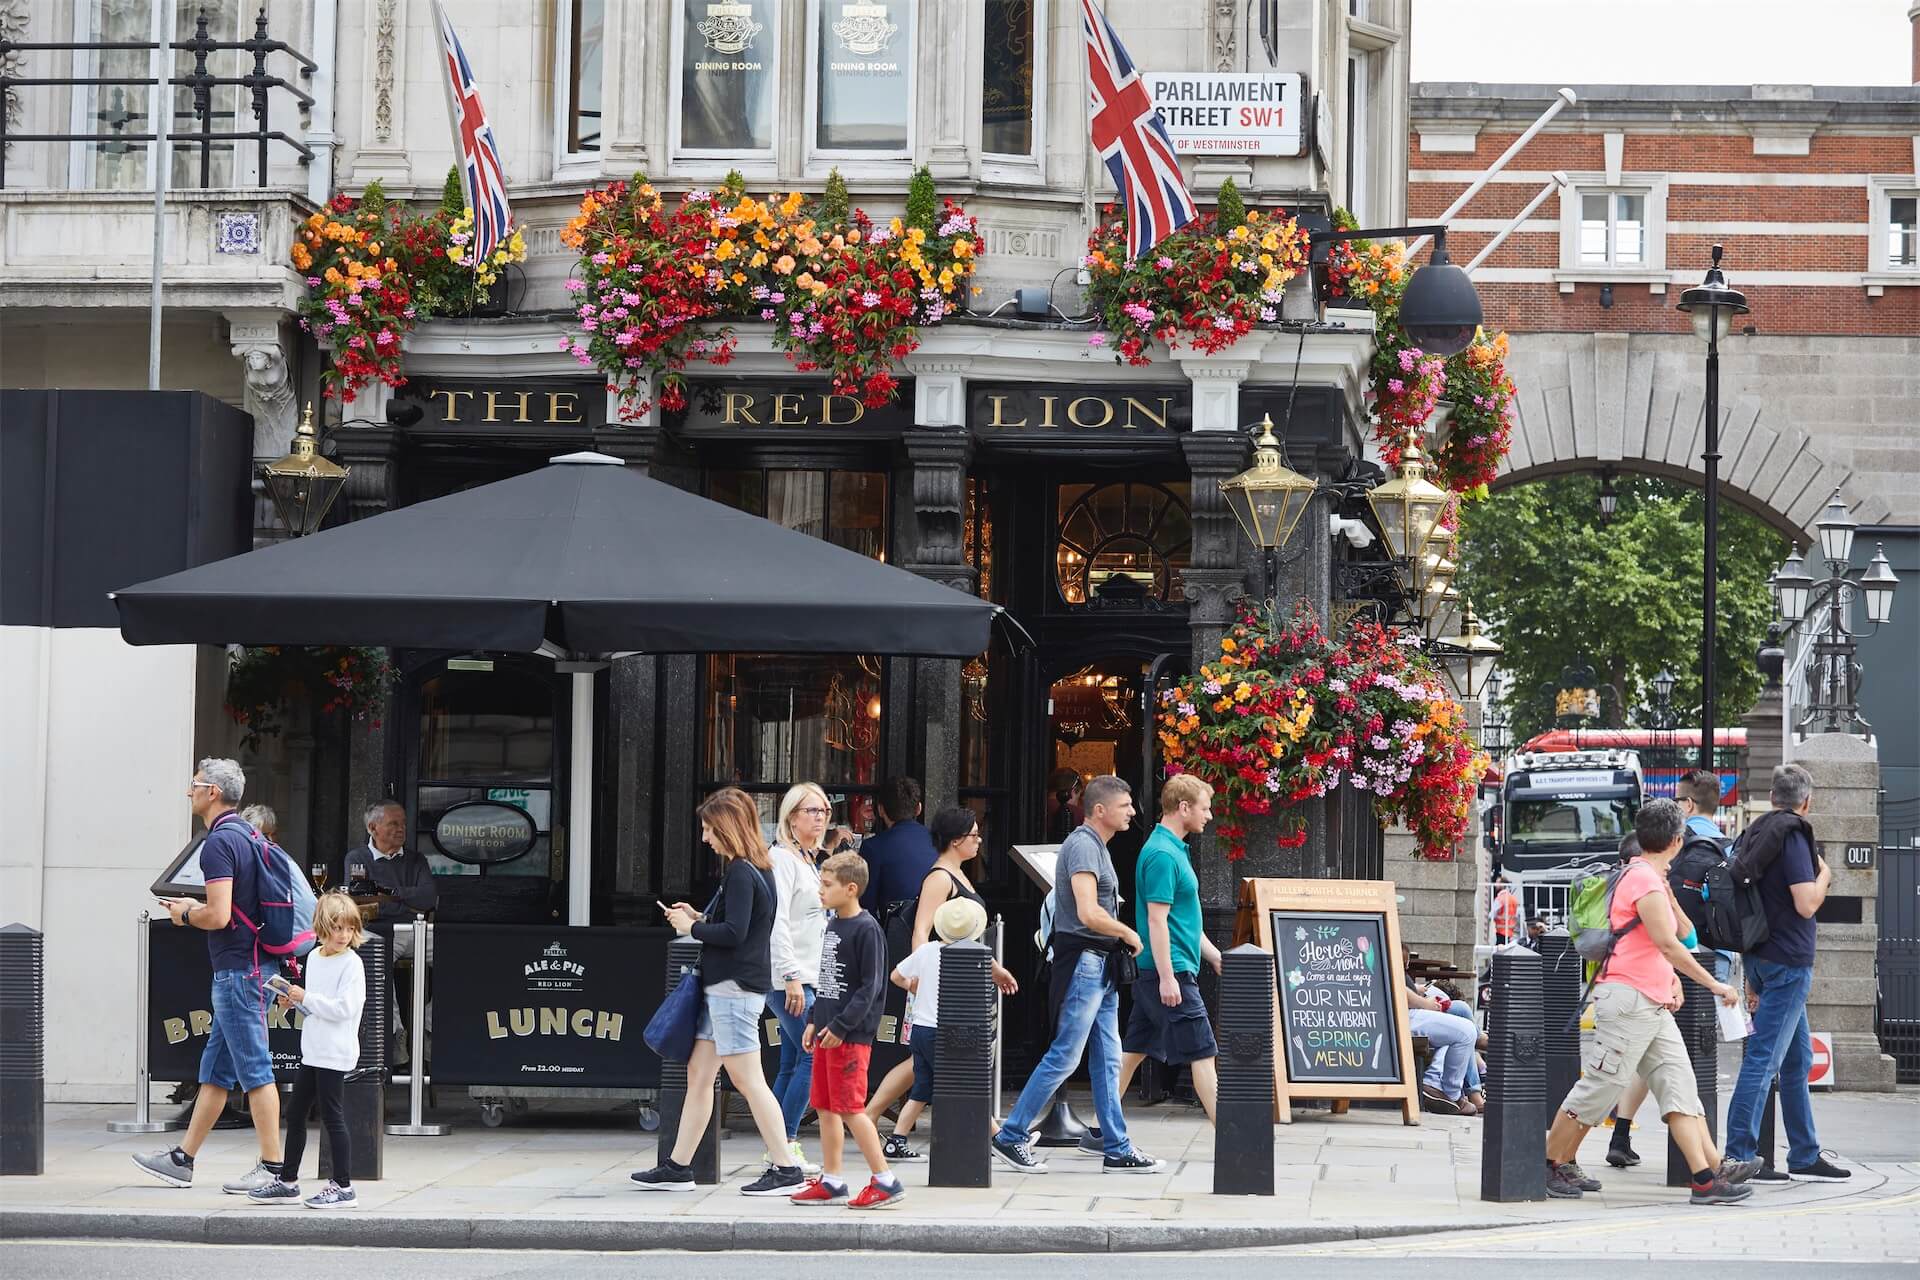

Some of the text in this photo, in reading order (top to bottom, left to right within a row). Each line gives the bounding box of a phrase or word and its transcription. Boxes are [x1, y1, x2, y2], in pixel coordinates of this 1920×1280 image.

[695, 62, 762, 71] DINING ROOM
[831, 62, 897, 71] DINING ROOM
[1155, 81, 1287, 102] PARLIAMENT
[1155, 106, 1284, 128] STREET SW1
[1177, 139, 1190, 150] OF
[1193, 139, 1261, 151] WESTMINSTER
[430, 389, 582, 423] THE
[720, 392, 865, 425] RED
[987, 395, 1173, 429] LION
[442, 823, 525, 840] DINING ROOM
[475, 839, 506, 848] FLOOR
[1848, 847, 1871, 864] OUT
[1304, 887, 1333, 896] SMITH
[1344, 888, 1379, 897] TURNER
[1299, 941, 1342, 964] Here
[524, 960, 585, 976] ALE & PIE
[1306, 971, 1372, 987] Come in and enjoy
[1295, 988, 1372, 1007] OUR NEW
[487, 1007, 624, 1041] LUNCH
[1292, 1010, 1377, 1028] FRESH & VIBRANT
[1307, 1030, 1371, 1048] SPRING
[1314, 1050, 1364, 1067] MENU
[521, 1064, 537, 1072] From
[537, 1064, 561, 1072] 12.00
